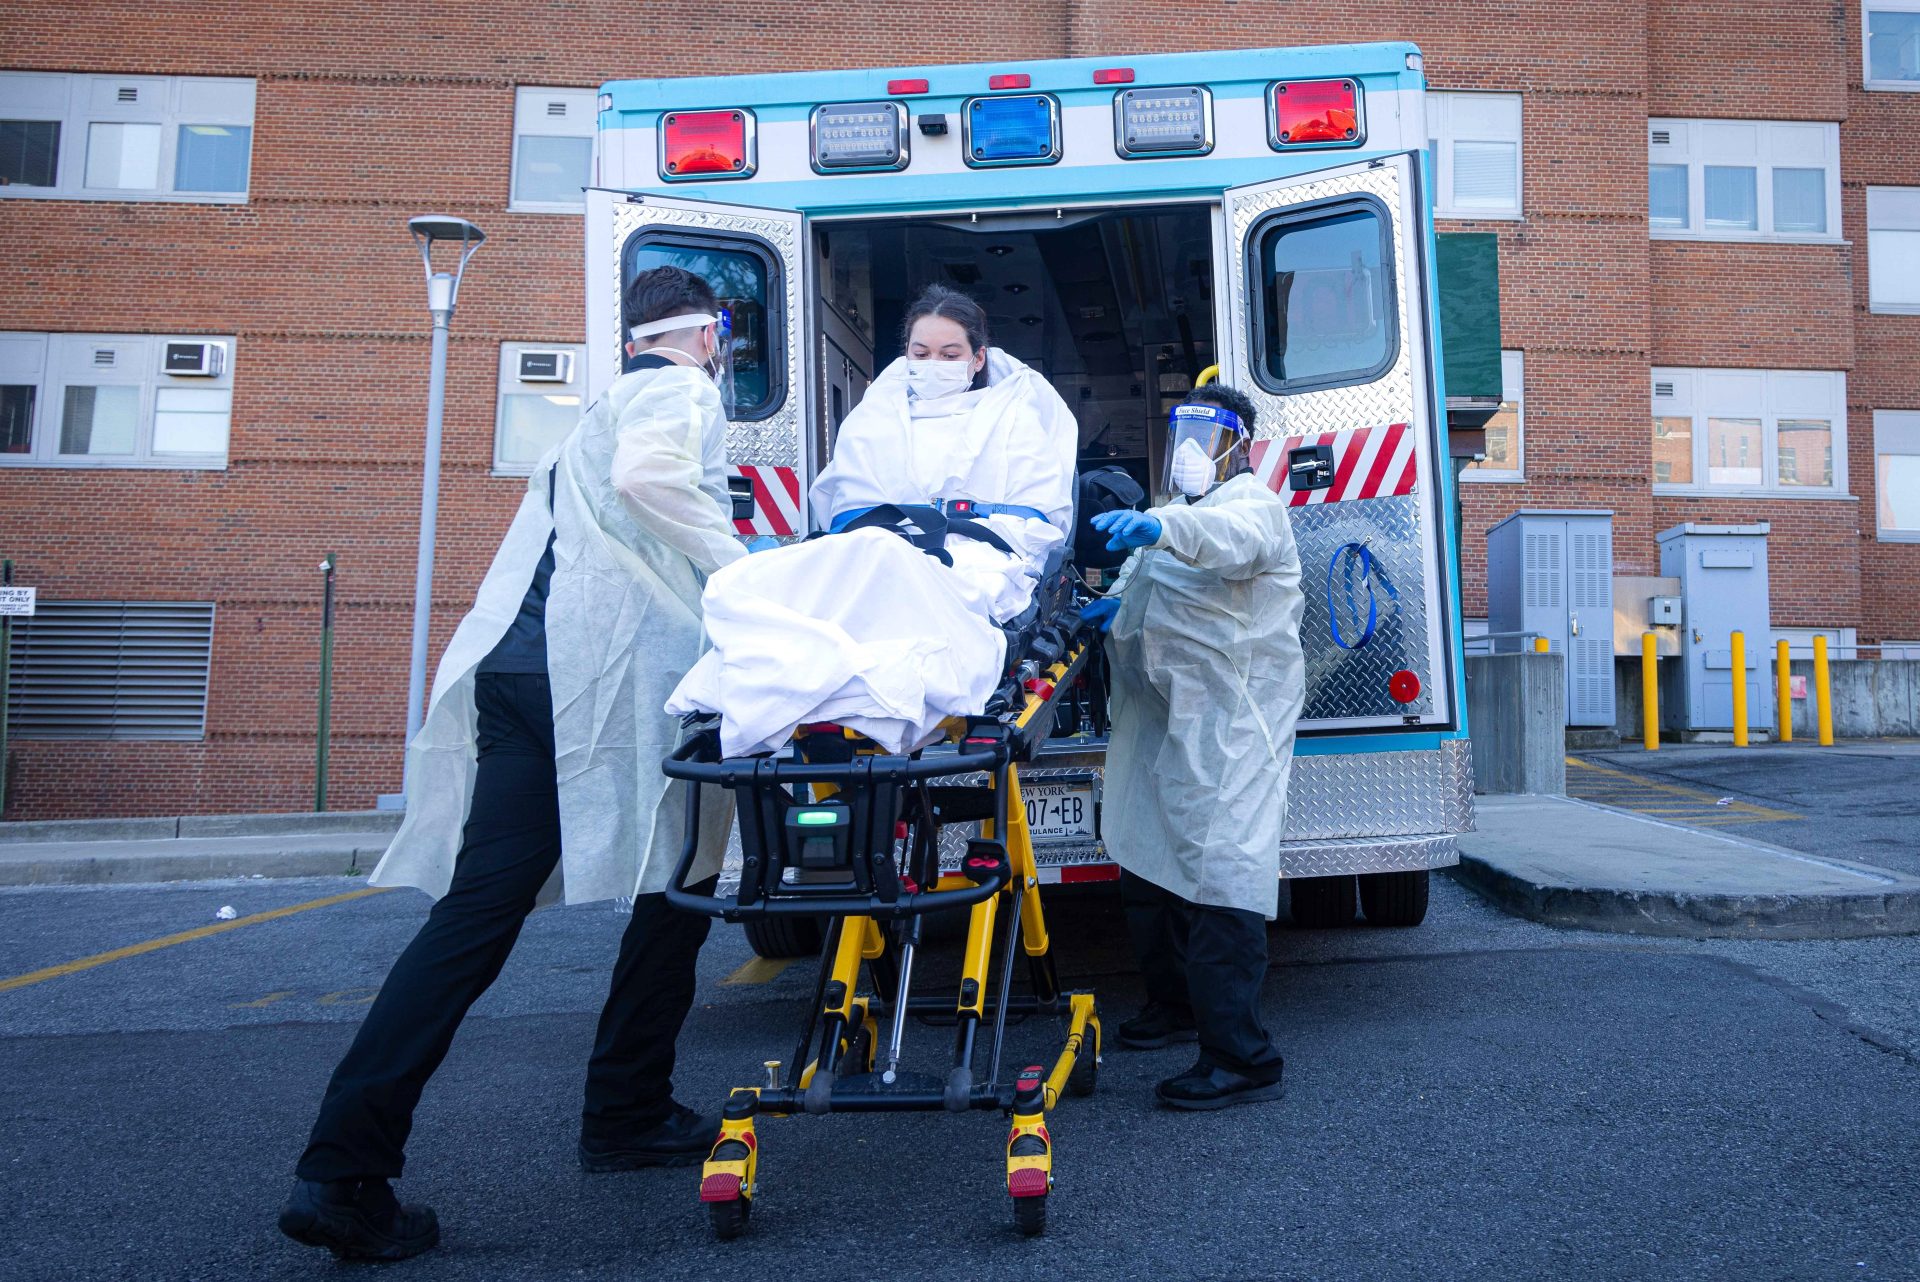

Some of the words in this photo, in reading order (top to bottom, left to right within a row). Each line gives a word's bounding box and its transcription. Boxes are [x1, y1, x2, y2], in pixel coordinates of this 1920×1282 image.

[1020, 788, 1035, 797] EW
[1037, 786, 1065, 797] YORK
[1025, 799, 1047, 826] 07
[1061, 797, 1083, 825] EB
